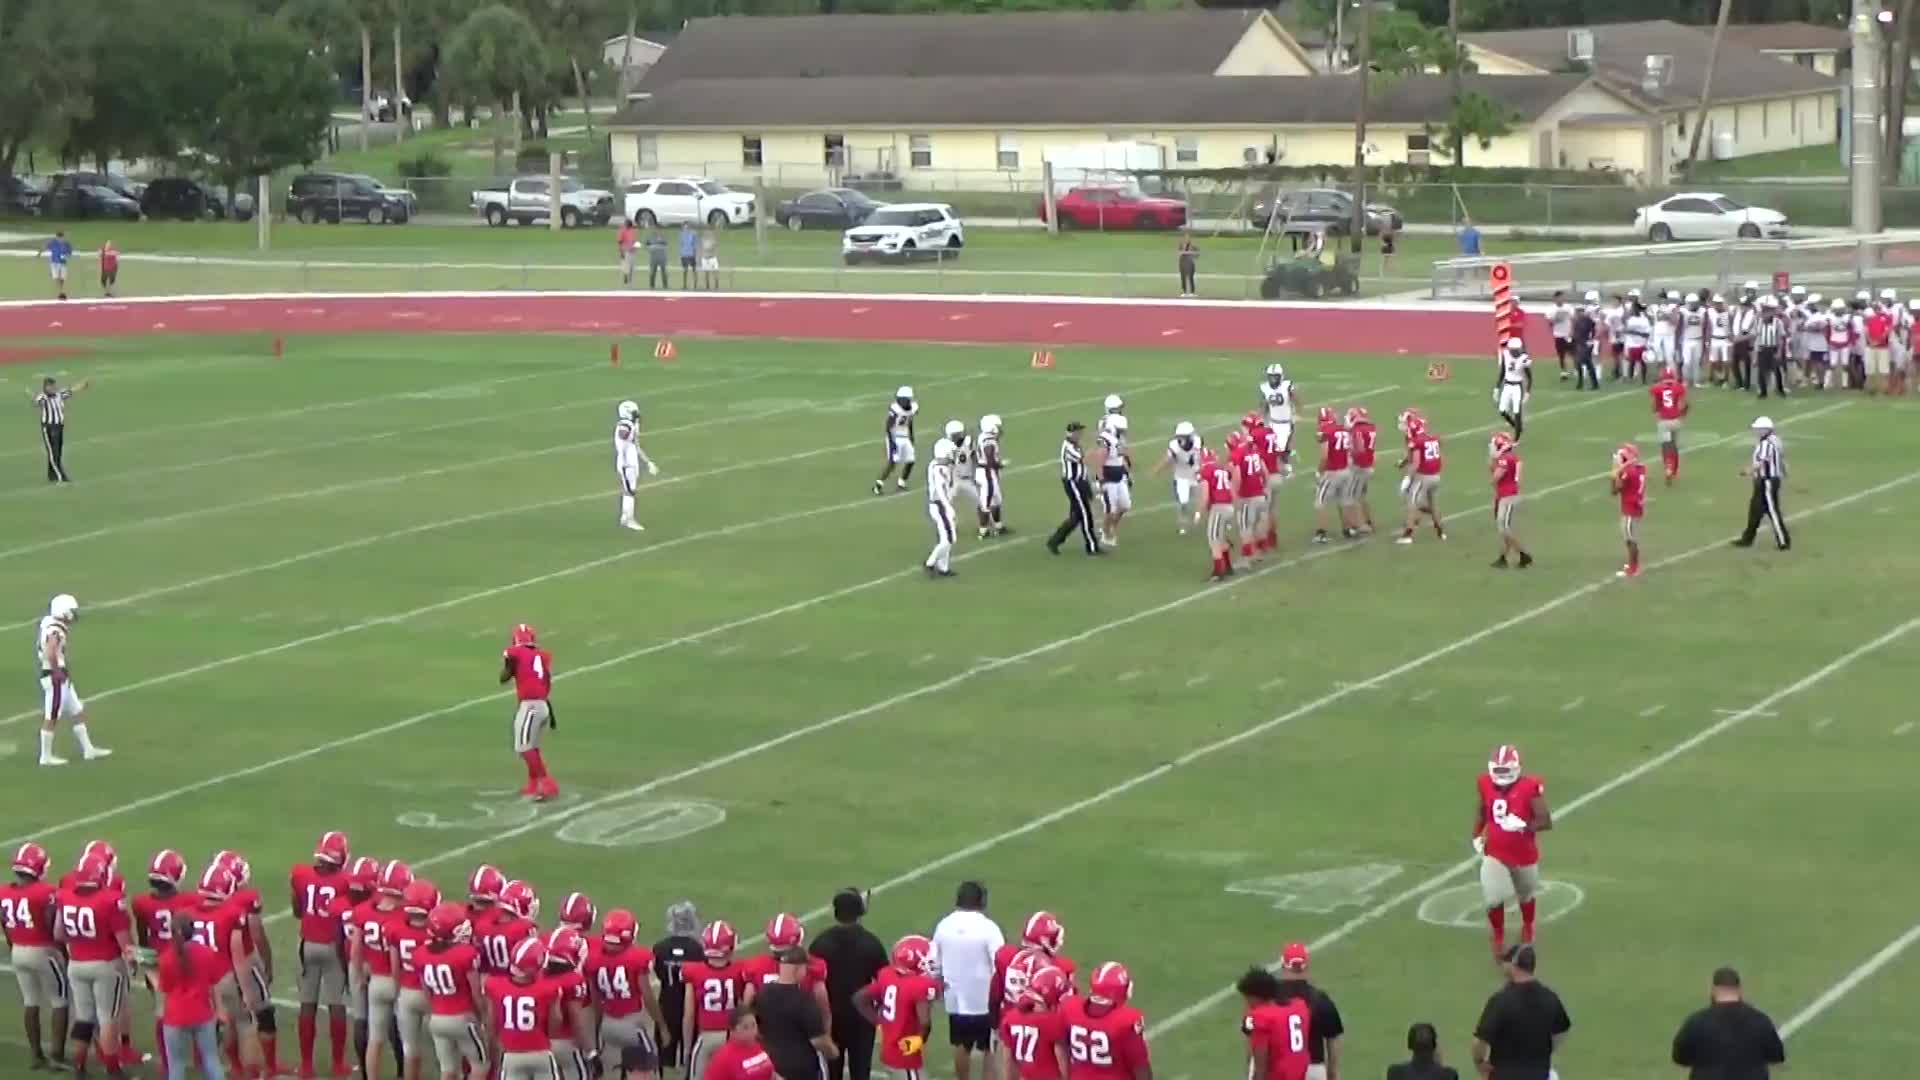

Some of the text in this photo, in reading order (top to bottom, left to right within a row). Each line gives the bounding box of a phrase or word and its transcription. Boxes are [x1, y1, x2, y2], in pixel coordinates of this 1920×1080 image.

[1662, 389, 1673, 408] 5
[532, 655, 543, 679] 4
[1, 897, 34, 929] 34
[63, 905, 97, 938] 50
[483, 934, 510, 968] 10
[424, 964, 456, 995] 40
[597, 965, 631, 999] 44
[704, 978, 735, 1011] 21
[502, 995, 536, 1031] 16
[882, 984, 897, 1021] 9
[1010, 1024, 1039, 1063] 77
[1070, 1024, 1113, 1065] 52
[1289, 1014, 1303, 1053] 6
